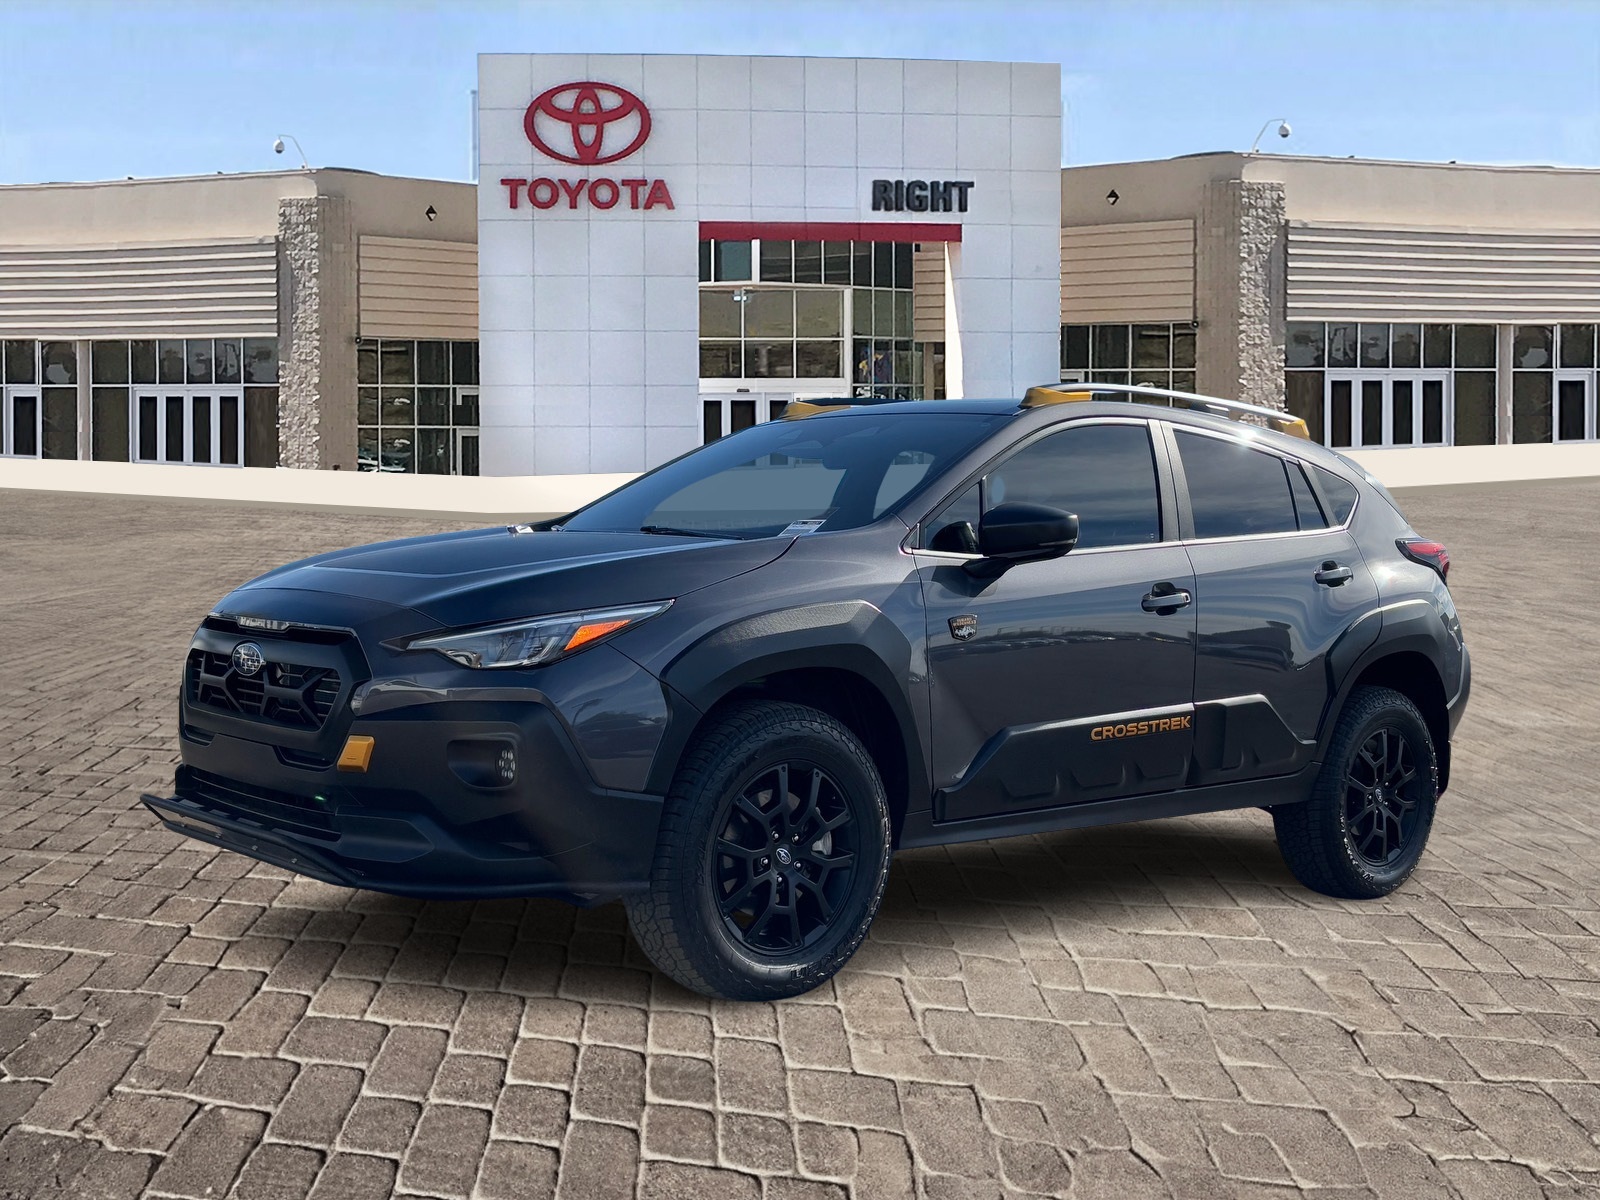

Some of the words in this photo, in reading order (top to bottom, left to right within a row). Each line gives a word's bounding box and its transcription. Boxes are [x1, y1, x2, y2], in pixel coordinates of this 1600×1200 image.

[500, 178, 675, 210] TOYOTA
[871, 180, 975, 212] RIGHT
[1090, 715, 1191, 741] CROSSTREK
